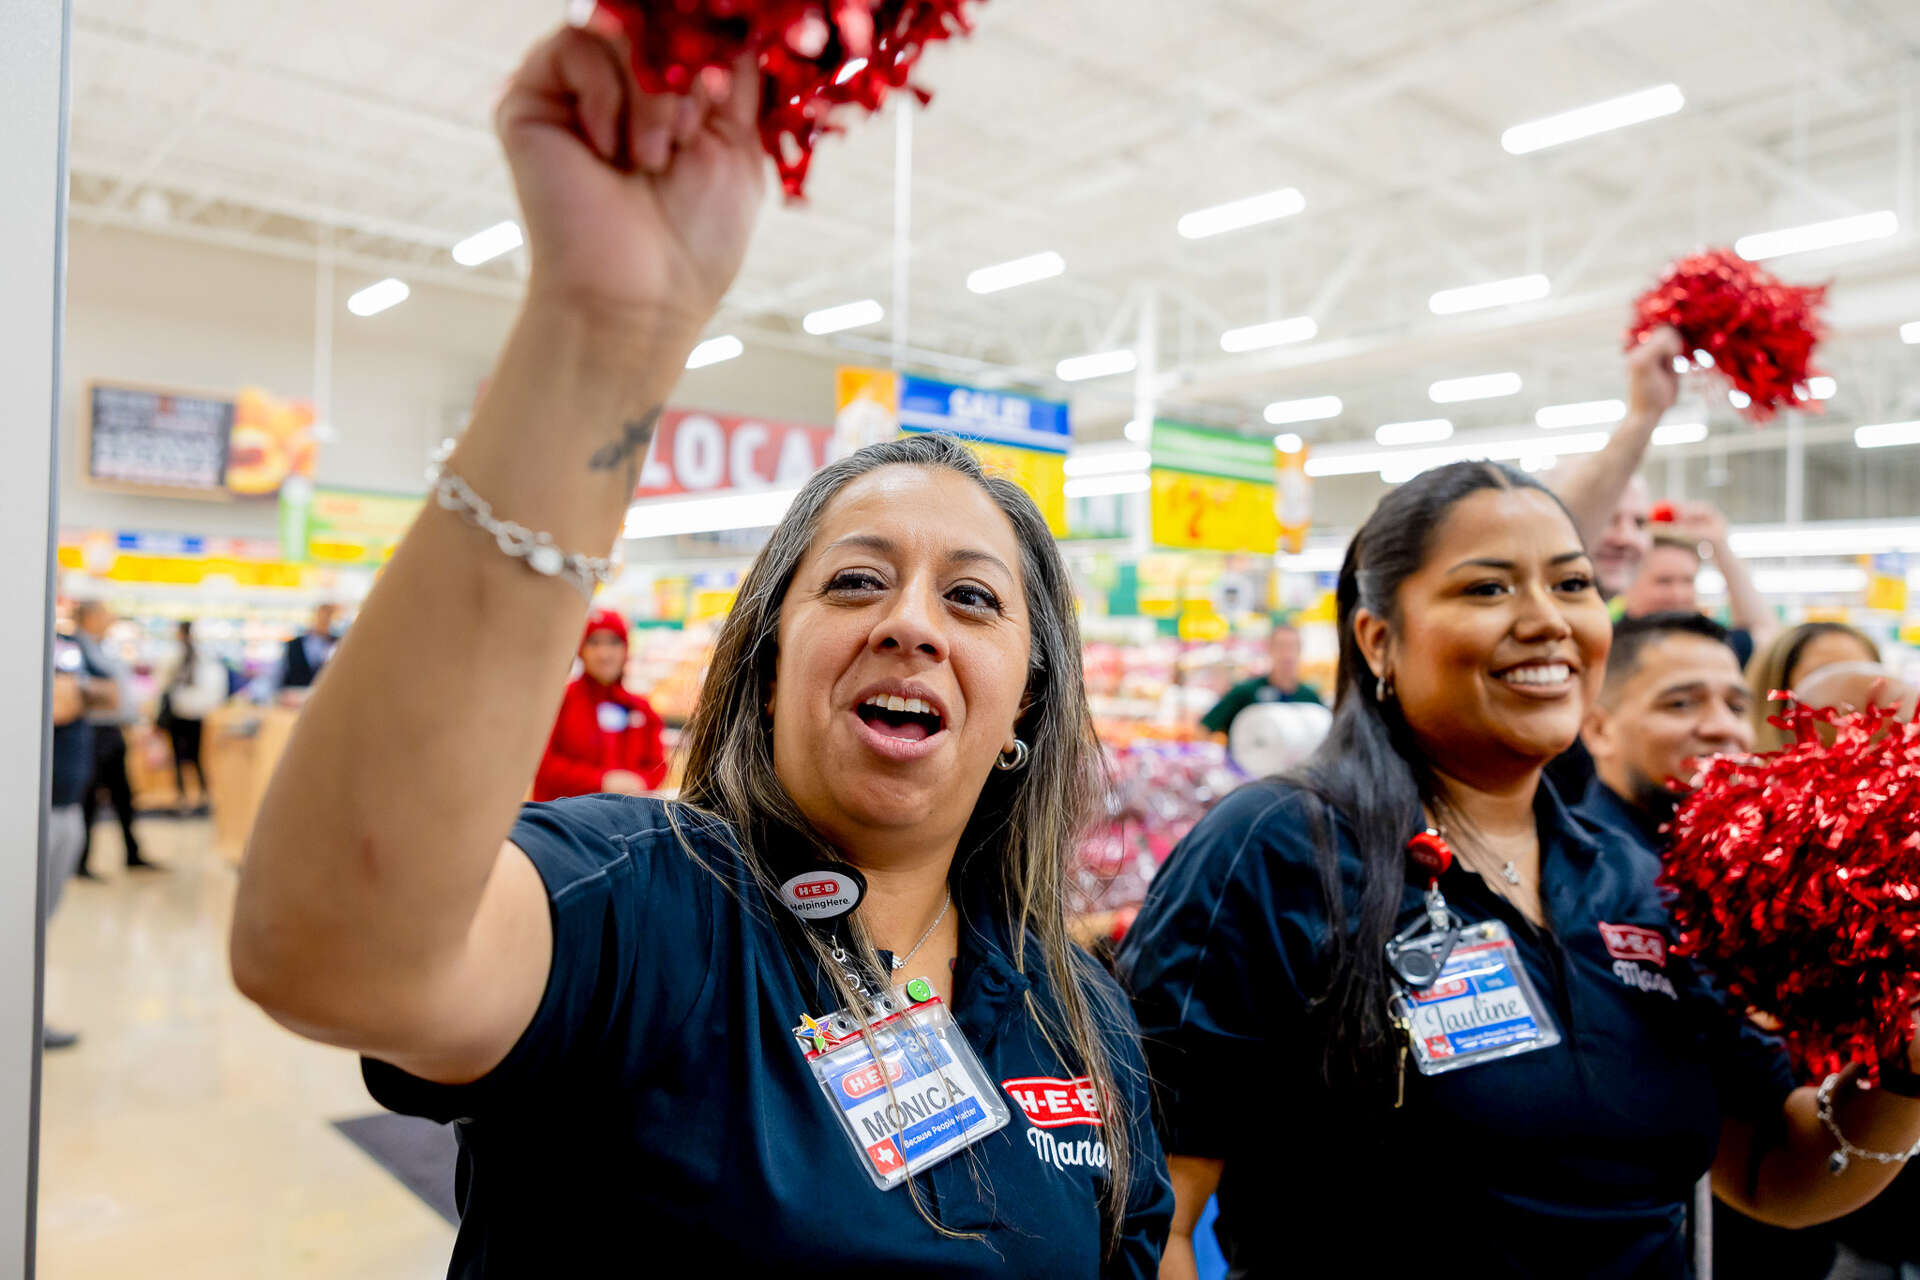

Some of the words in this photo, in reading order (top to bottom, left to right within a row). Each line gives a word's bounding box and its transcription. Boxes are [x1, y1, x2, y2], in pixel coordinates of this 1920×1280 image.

[639, 414, 836, 492] LOCA
[848, 1062, 897, 1092] H-EB
[862, 1077, 965, 1142] MONICA
[1011, 1089, 1099, 1113] H-E-B
[904, 1128, 933, 1149] Because
[931, 1116, 955, 1134] People
[1027, 1127, 1112, 1171] Mana
